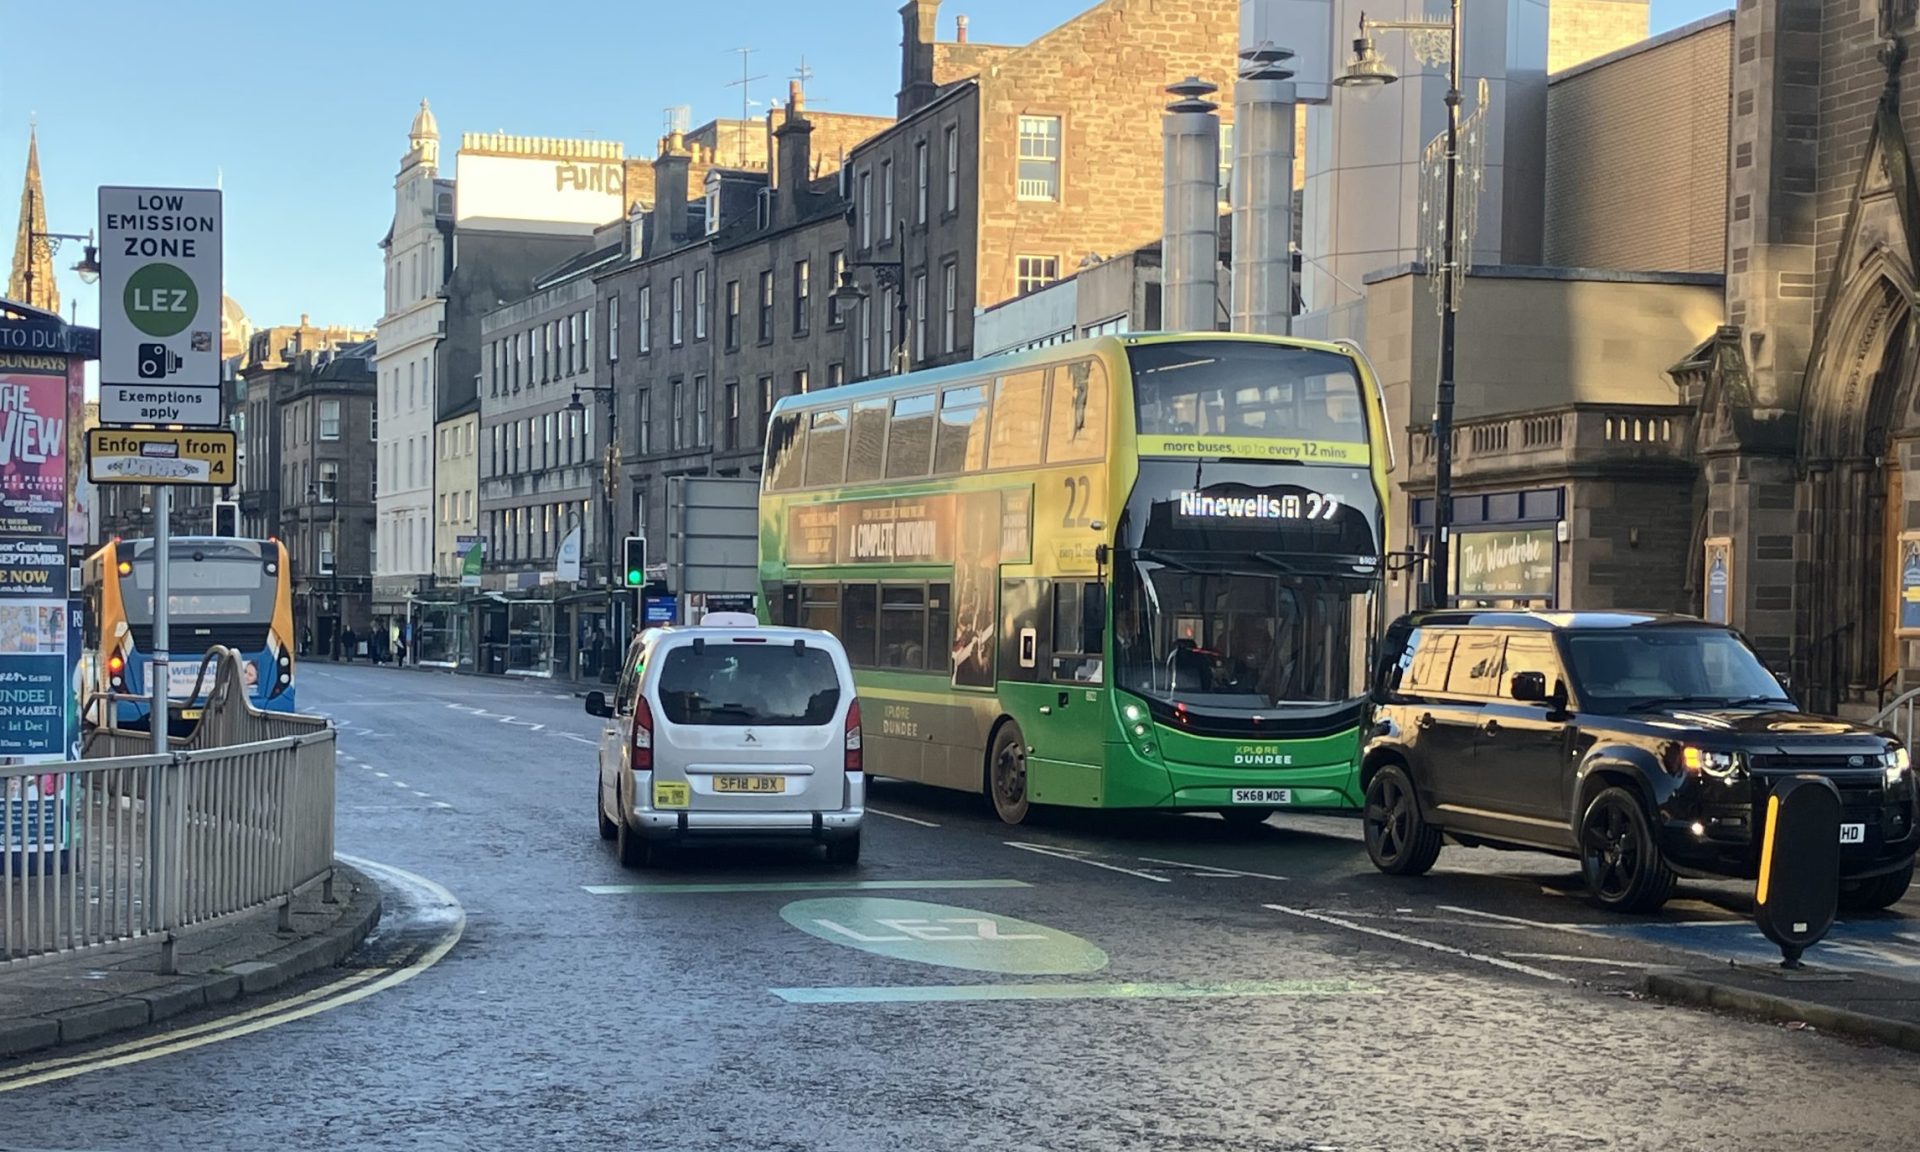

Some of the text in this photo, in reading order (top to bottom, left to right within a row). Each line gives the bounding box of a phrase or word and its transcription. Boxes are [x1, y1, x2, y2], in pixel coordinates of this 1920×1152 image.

[138, 195, 183, 211] LOW
[107, 214, 214, 232] EMISSION
[124, 237, 196, 257] ZONE
[134, 288, 187, 312] LEZ
[0, 328, 26, 346] TO
[118, 390, 202, 405] Exemptions
[141, 407, 179, 420] apply
[186, 439, 226, 453] from
[1163, 442, 1194, 452] more
[1197, 441, 1235, 454] buses,
[1268, 445, 1300, 458] every
[1302, 443, 1317, 456] 12
[1320, 447, 1347, 459] mins
[209, 460, 224, 474] 4
[0, 482, 63, 490] ETECTIVES
[1062, 476, 1090, 528] 22
[1180, 491, 1280, 518] Ninewells
[1464, 533, 1541, 578] The Wardrobe
[10, 570, 49, 584] NOW
[0, 690, 45, 702] NDEE
[16, 706, 57, 715] MARKET
[883, 720, 918, 736] DUNDEE
[1235, 746, 1279, 754] XPLORE
[1234, 755, 1292, 764] DUNDEE
[720, 778, 778, 790] SF18 JBX
[1236, 790, 1287, 801] SK68 MDE
[1841, 826, 1859, 840] HD
[811, 918, 1050, 942] LEZ
